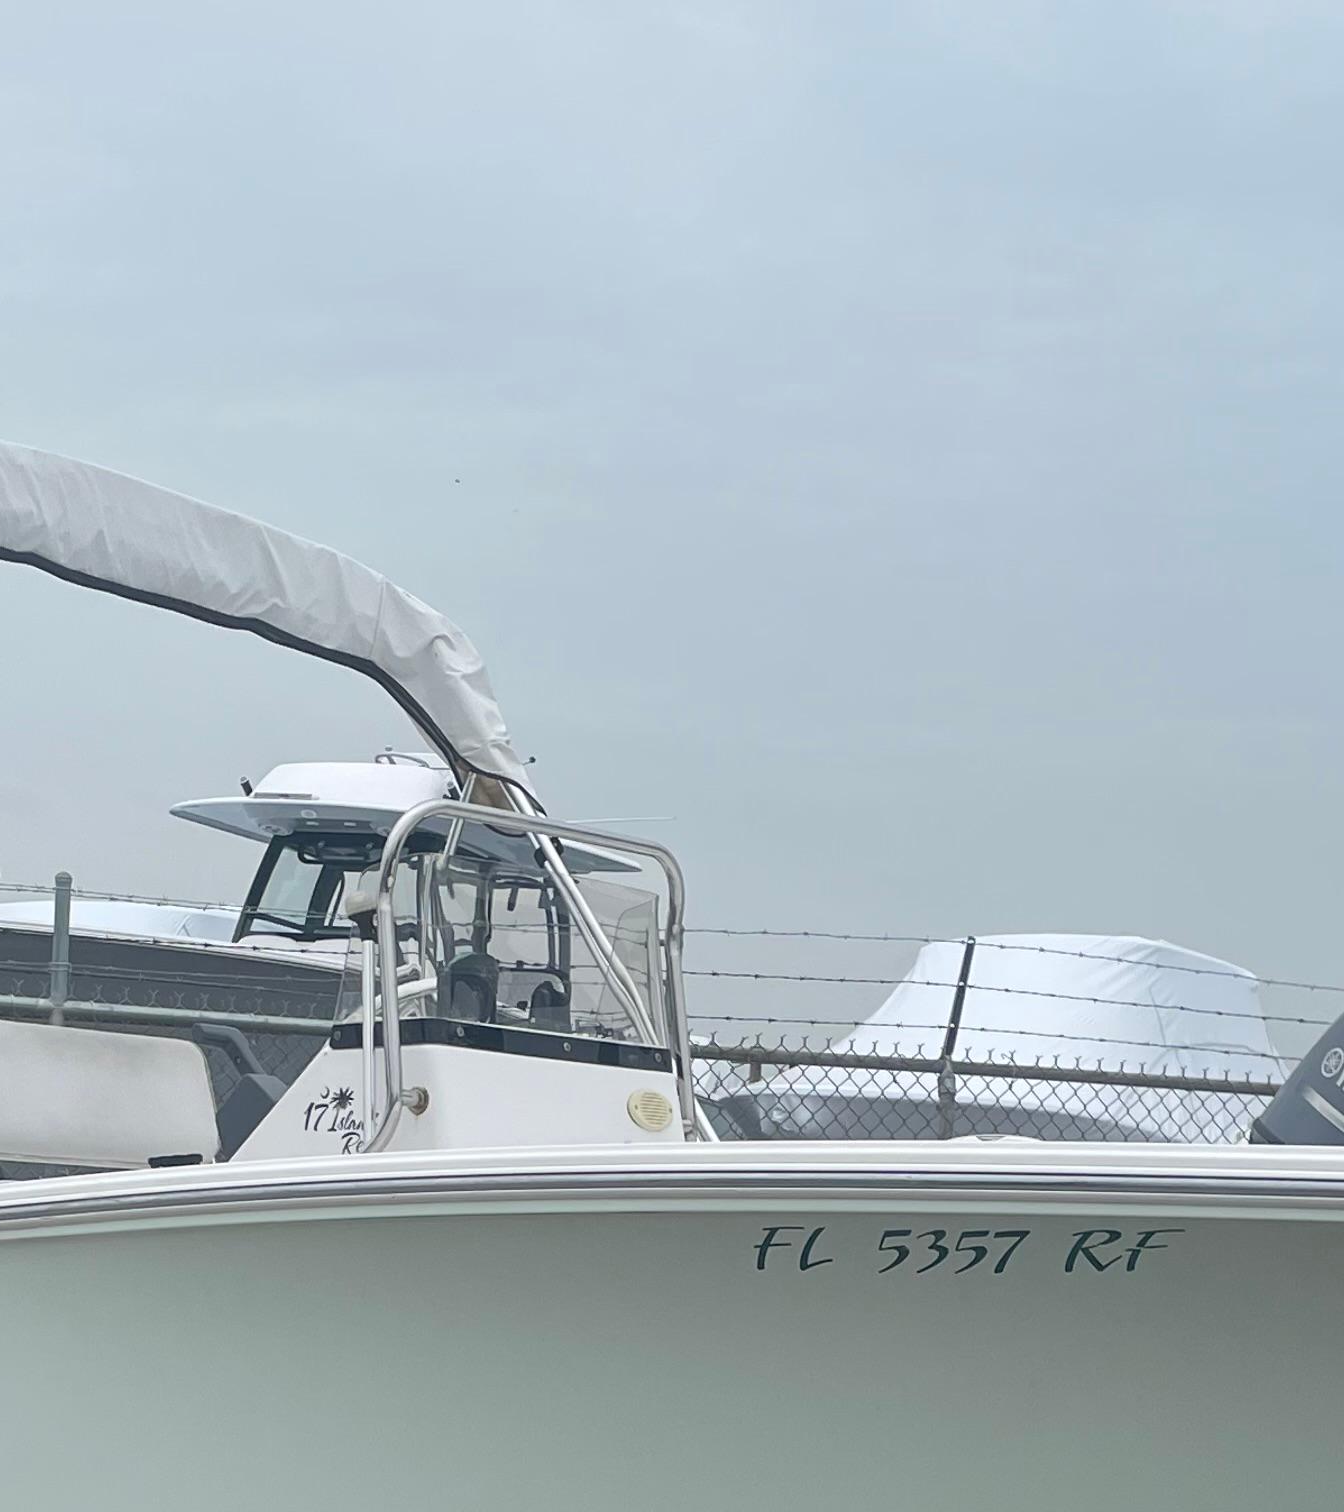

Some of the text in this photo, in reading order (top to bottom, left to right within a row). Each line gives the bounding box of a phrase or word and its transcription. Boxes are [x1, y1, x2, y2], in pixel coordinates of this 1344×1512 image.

[304, 1102, 329, 1132] 17
[754, 1226, 1186, 1275] FL 5357 RF
